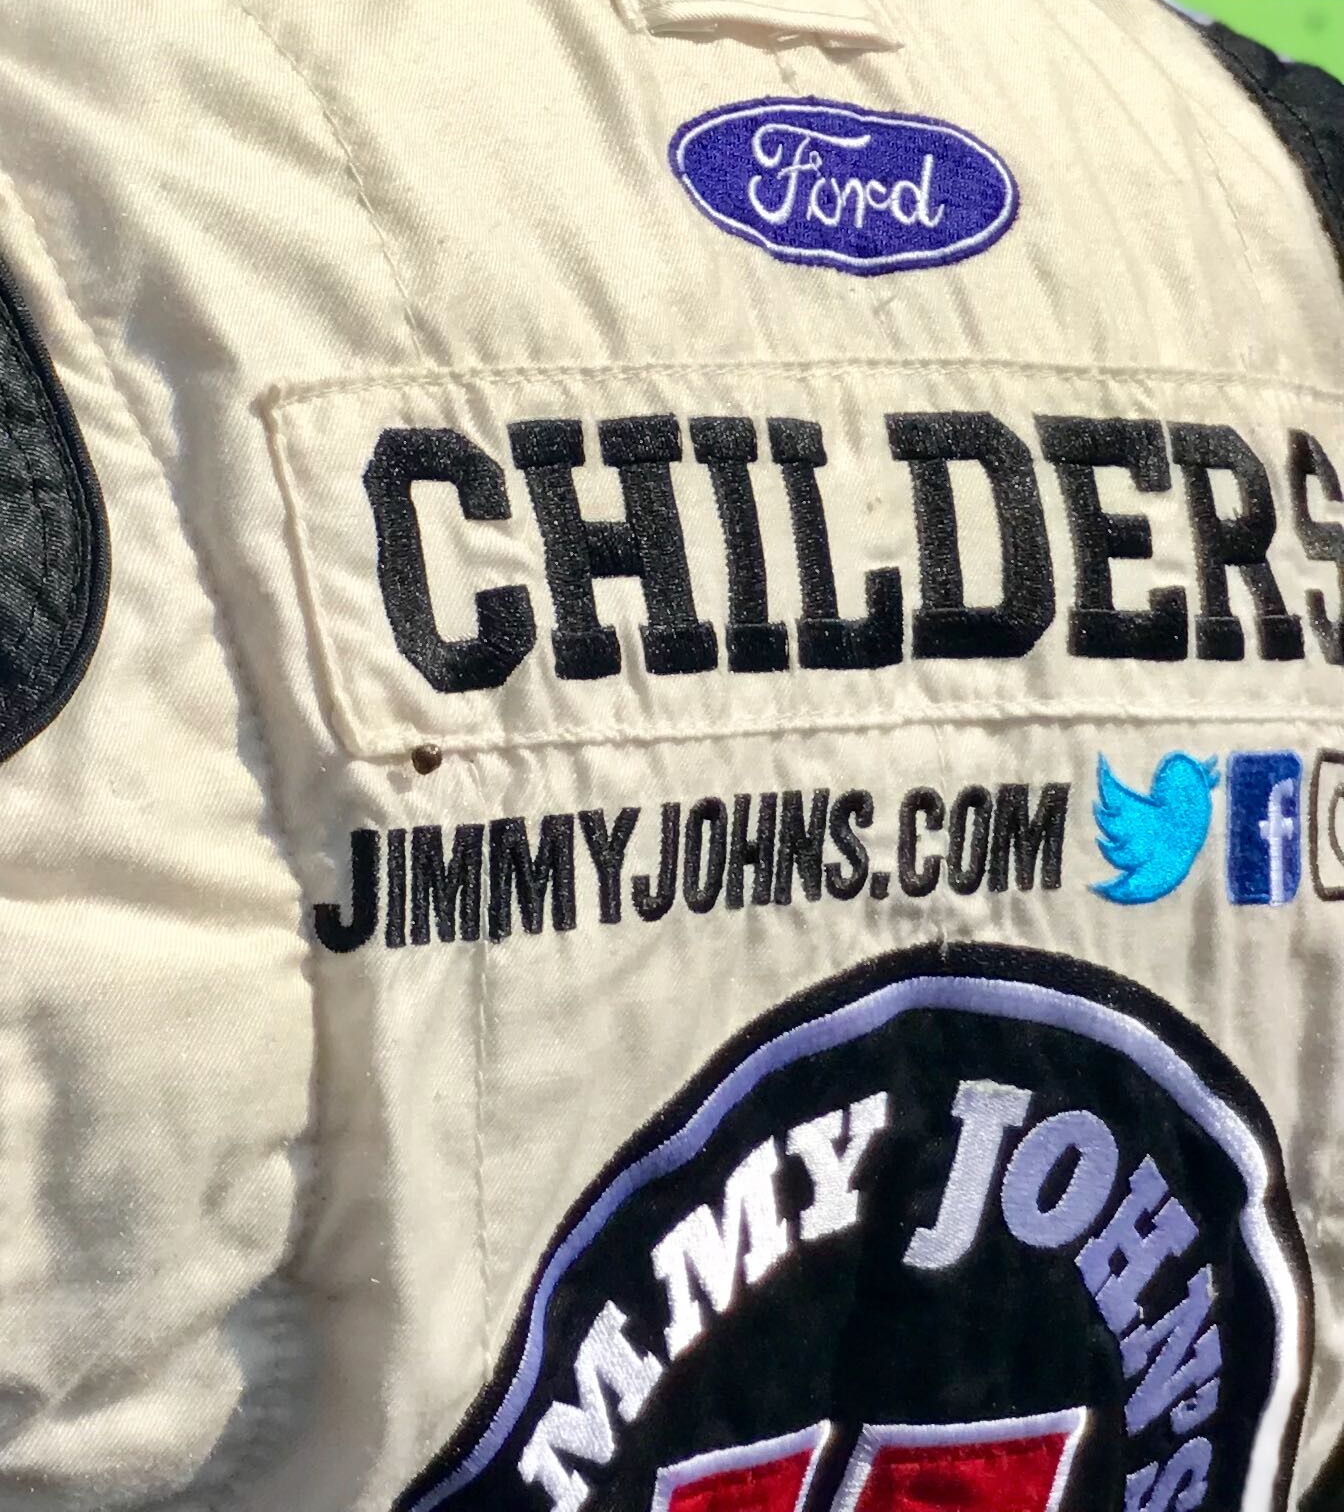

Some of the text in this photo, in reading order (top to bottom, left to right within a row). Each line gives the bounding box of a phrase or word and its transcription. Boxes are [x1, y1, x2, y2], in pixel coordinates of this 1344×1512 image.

[747, 122, 946, 229] Ford
[313, 782, 1073, 954] JIMMYJOHNS.COM
[516, 1090, 891, 1512] MMY
